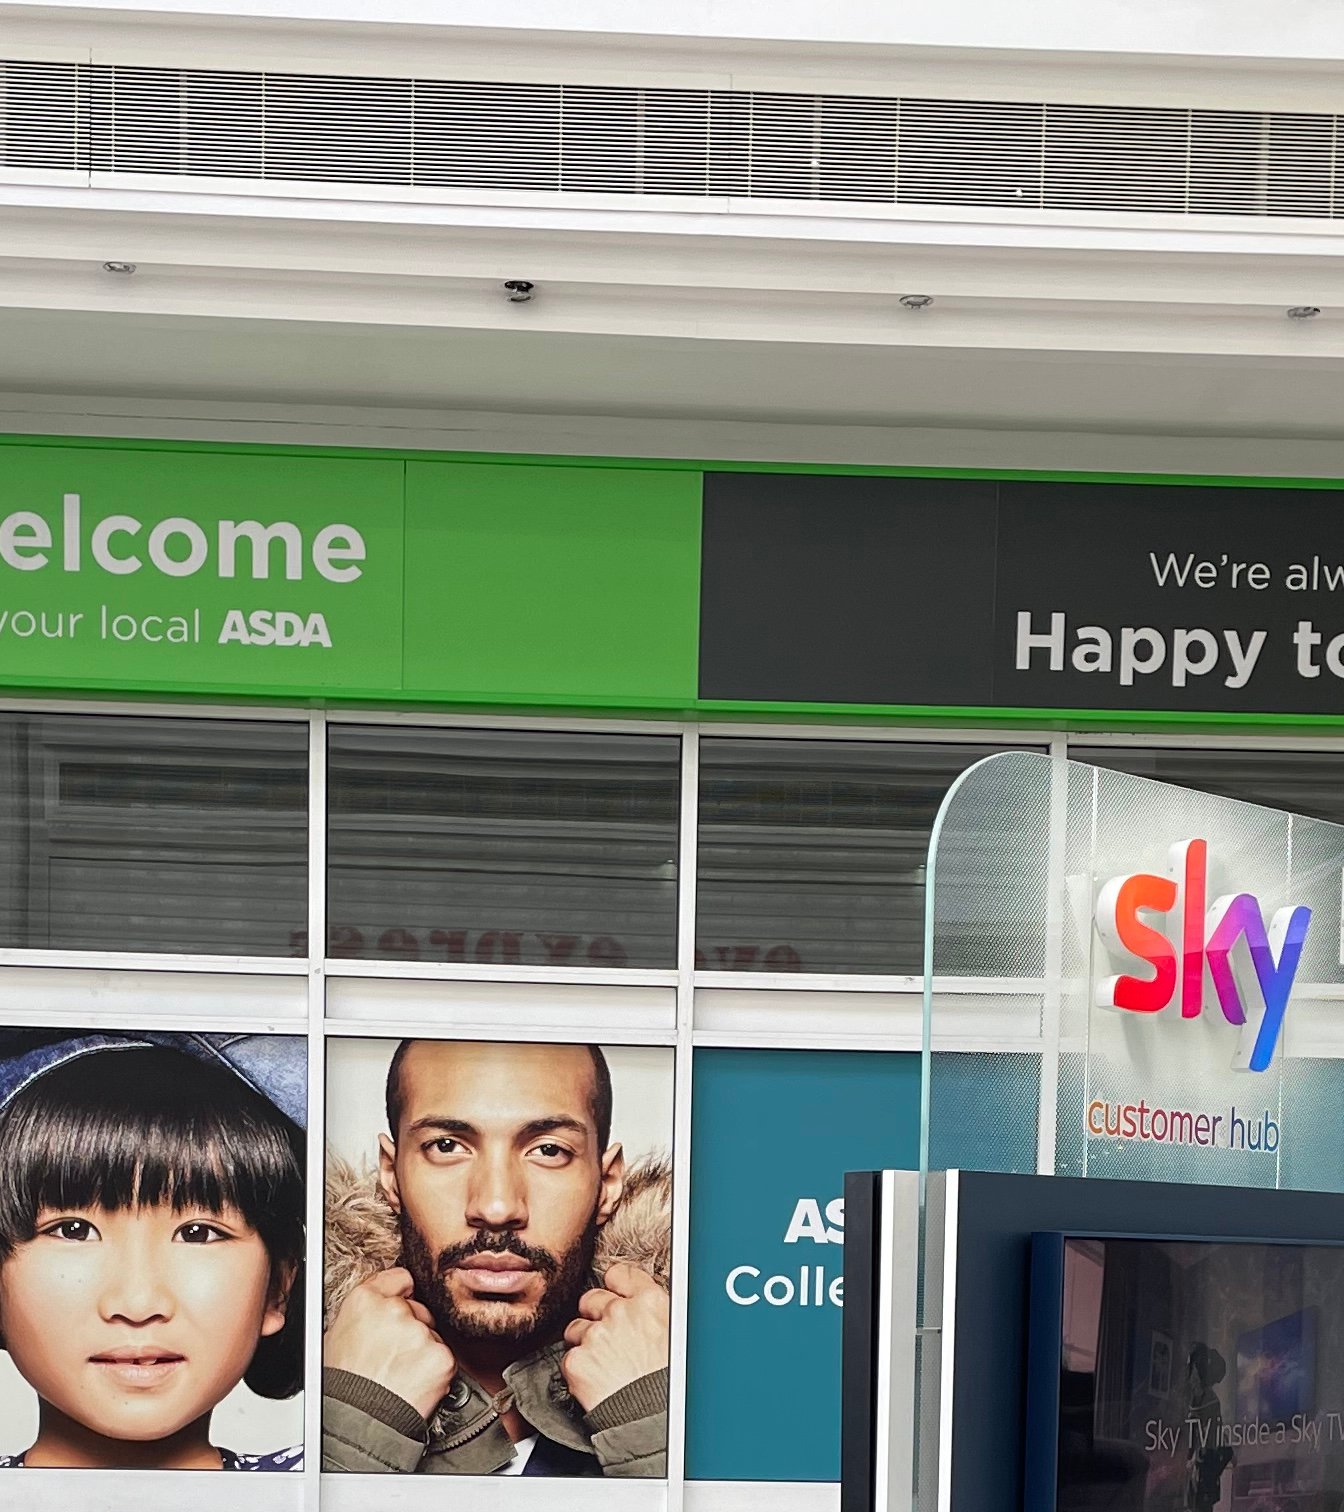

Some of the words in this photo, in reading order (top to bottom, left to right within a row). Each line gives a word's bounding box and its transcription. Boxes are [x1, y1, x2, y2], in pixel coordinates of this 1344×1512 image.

[101, 606, 201, 645] local
[218, 609, 332, 649] ASDA
[1015, 611, 1267, 688] Happy
[1096, 837, 1313, 1073] sky
[1088, 1100, 1222, 1146] customer
[1230, 1108, 1280, 1153] hub
[1145, 1420, 1181, 1457] Sky
[1185, 1418, 1212, 1449] TV
[1215, 1417, 1270, 1447] inside
[1275, 1423, 1286, 1444] a
[1291, 1414, 1323, 1449] Sky
